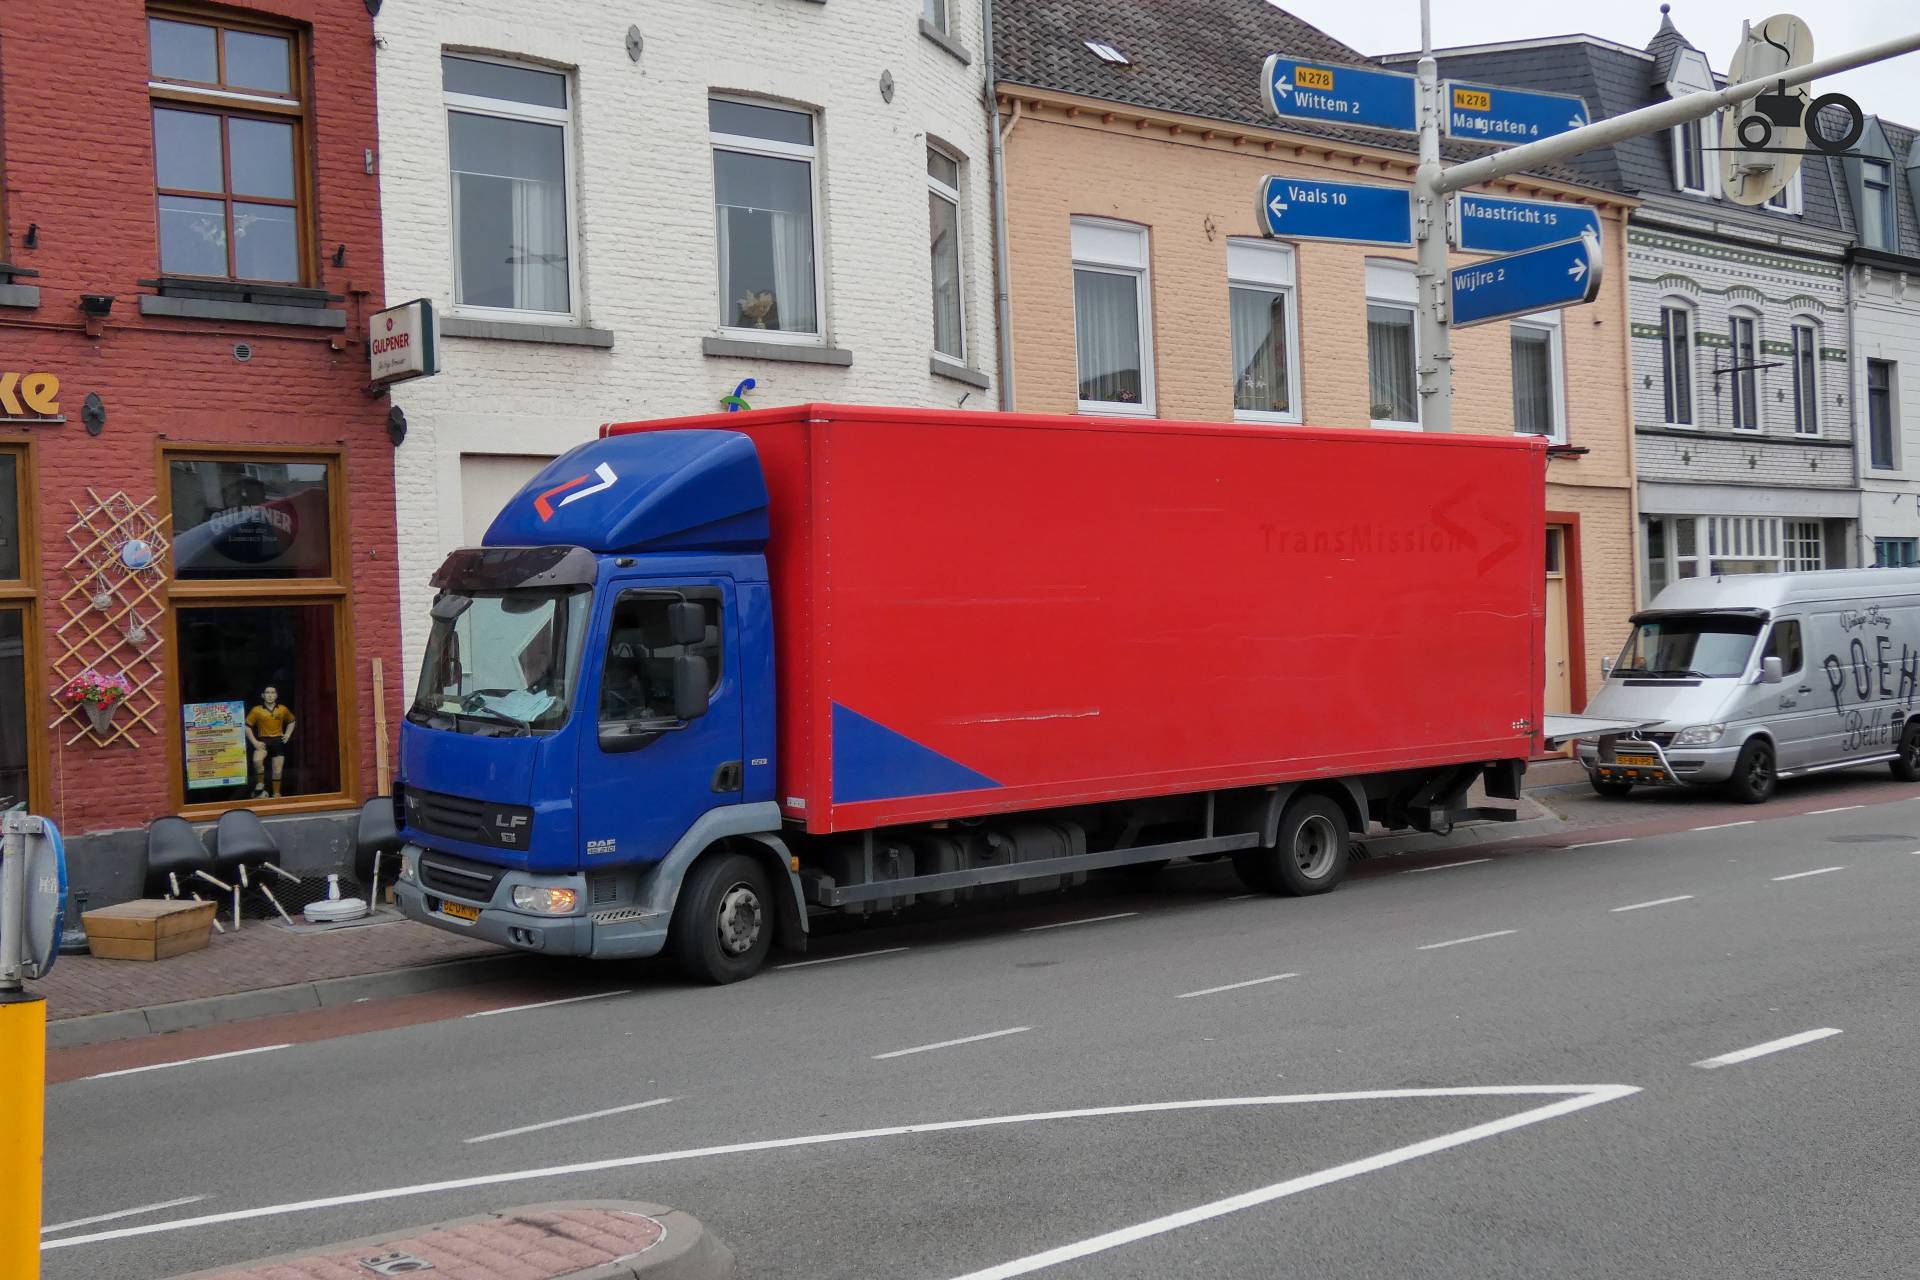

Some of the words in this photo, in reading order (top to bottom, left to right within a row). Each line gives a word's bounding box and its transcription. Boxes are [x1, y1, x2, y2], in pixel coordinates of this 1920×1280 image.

[1294, 91, 1348, 113] Wittem
[1352, 102, 1360, 114] 2
[1530, 124, 1538, 135] 4
[1288, 186, 1328, 204] Vaals
[1331, 193, 1347, 205] 10
[1464, 202, 1540, 224] Maastricht
[1543, 213, 1558, 225] 15
[1454, 271, 1494, 292] Wijlre
[1497, 268, 1505, 281] 2
[372, 333, 409, 356] GULPENER
[208, 505, 292, 536] GULPENER
[1258, 521, 1464, 554] TransMission
[1842, 708, 1888, 751] Belle
[495, 814, 528, 828] LF
[586, 839, 616, 848] DAF
